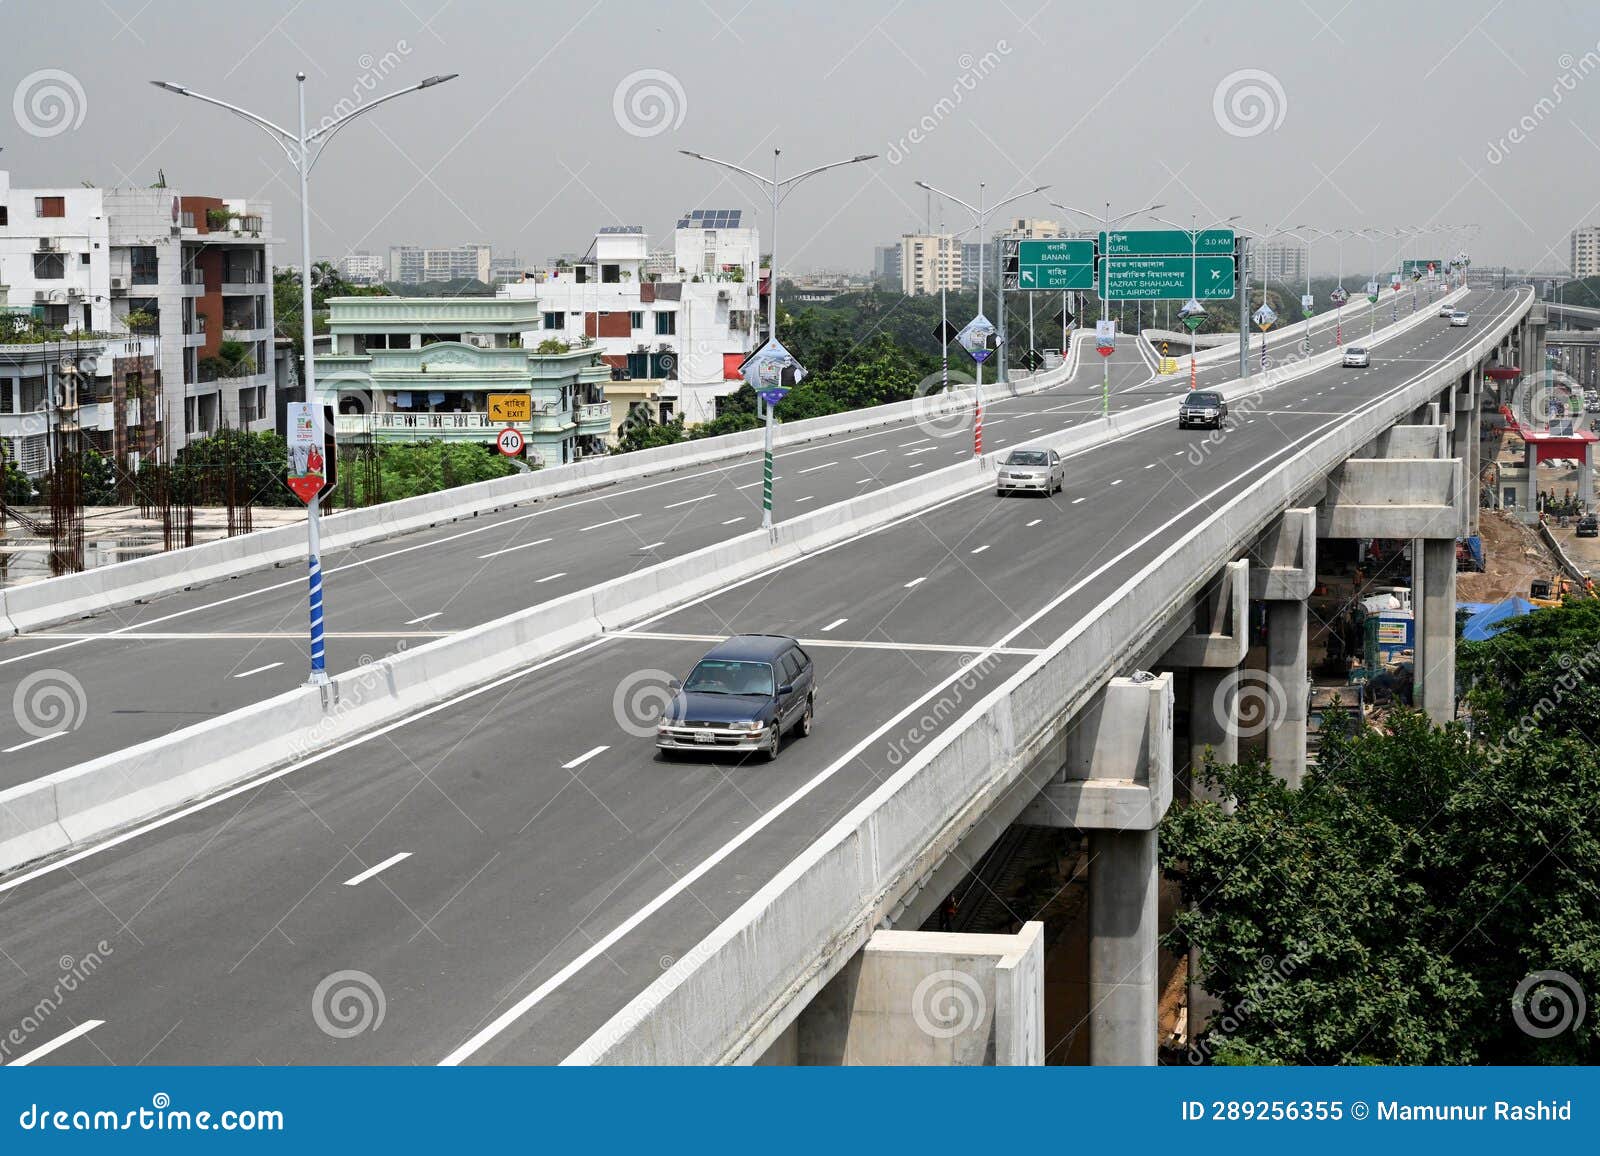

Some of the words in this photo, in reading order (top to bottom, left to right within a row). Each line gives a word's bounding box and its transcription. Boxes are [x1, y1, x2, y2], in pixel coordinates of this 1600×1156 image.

[1047, 243, 1067, 251] বনানী
[1047, 267, 1067, 276] বাহির
[504, 399, 525, 408] বাহির
[502, 436, 519, 447] 40
